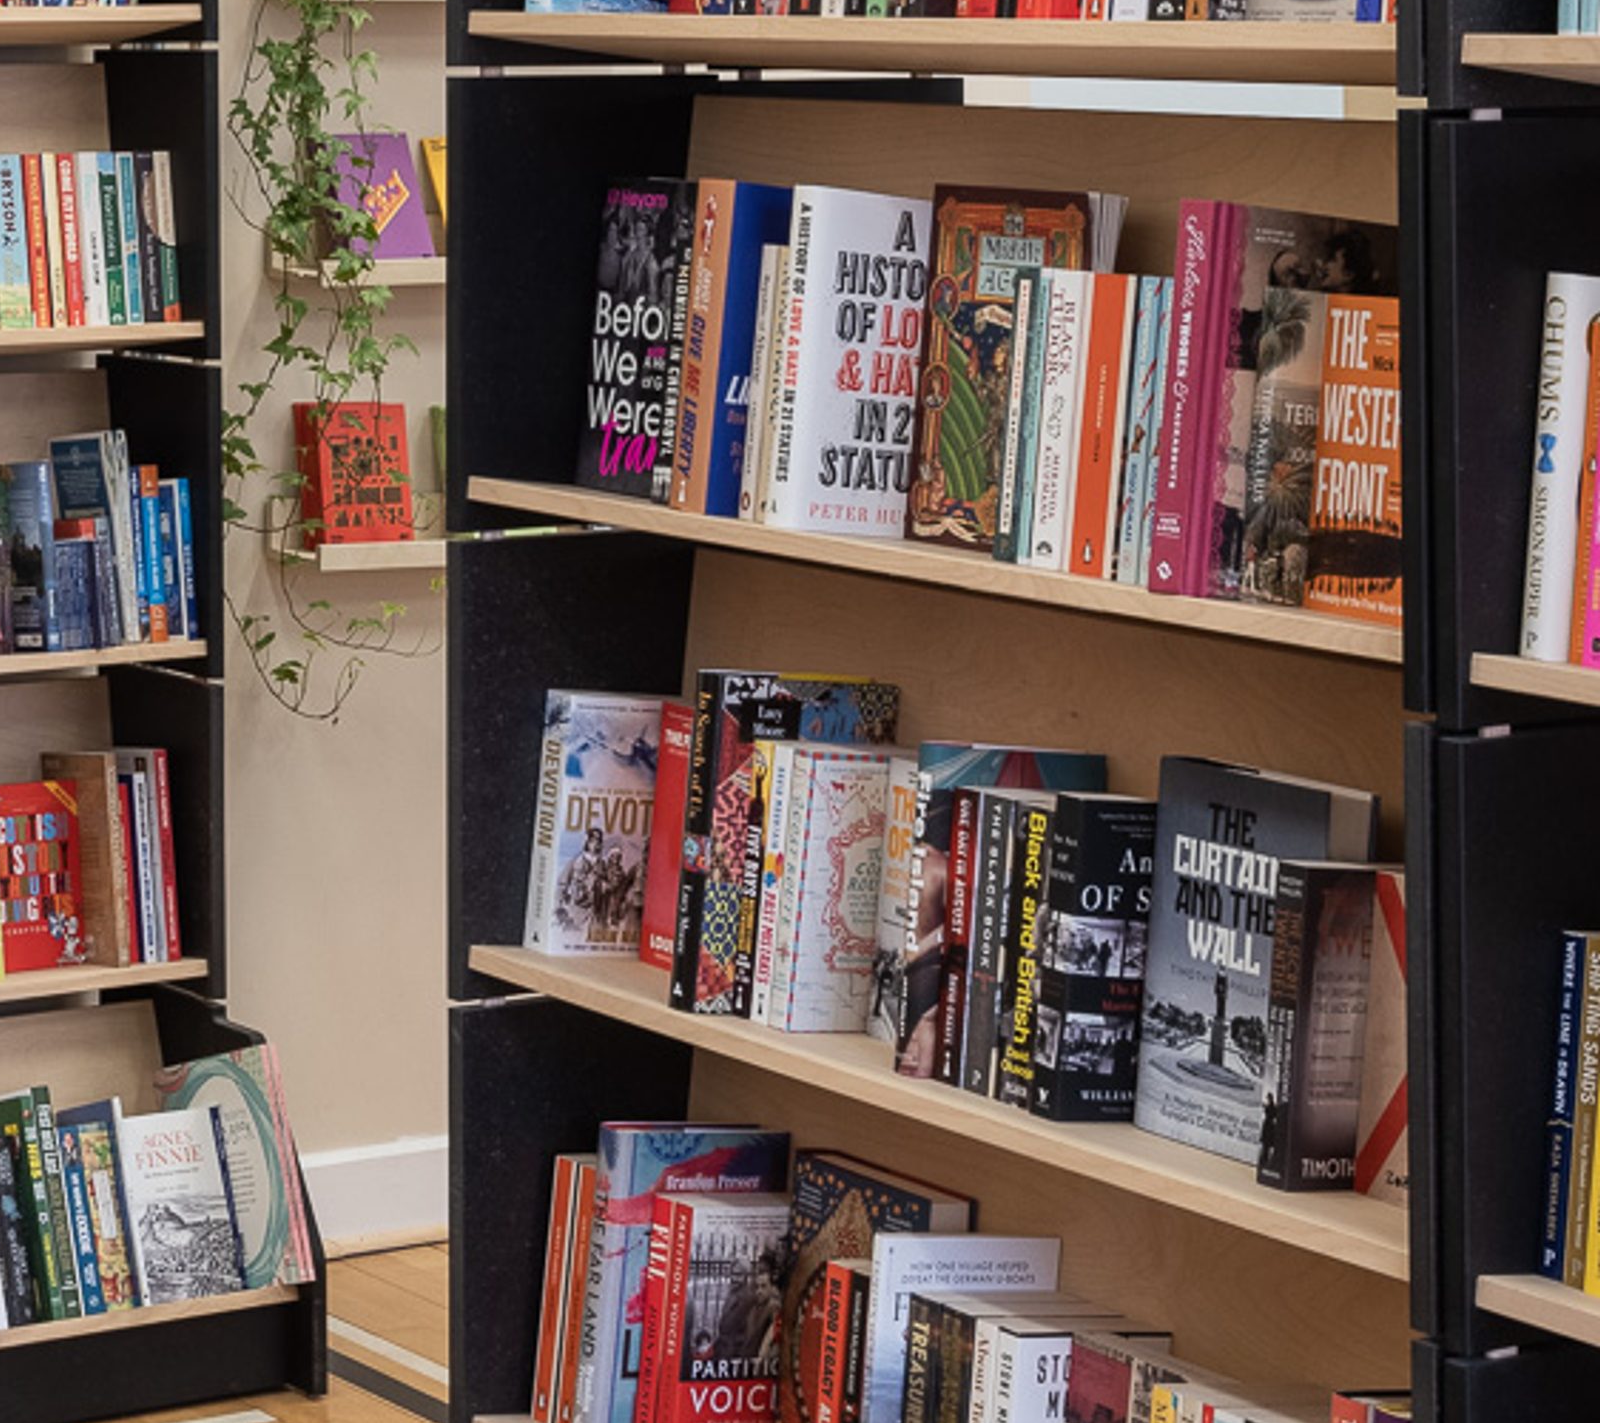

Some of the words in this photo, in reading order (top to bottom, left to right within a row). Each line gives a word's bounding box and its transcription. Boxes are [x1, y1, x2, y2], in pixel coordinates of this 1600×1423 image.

[0, 168, 16, 232] BRYSON
[894, 210, 917, 253] A
[689, 314, 705, 361] GIVE
[838, 300, 877, 345] OF
[881, 306, 924, 349] LO
[1176, 311, 1192, 377] WHORES
[1329, 307, 1369, 370] THE
[593, 340, 638, 385] We
[686, 363, 700, 395] ME
[836, 349, 862, 391] &
[1538, 296, 1567, 423] CHUMS
[589, 385, 661, 436] Were
[853, 399, 888, 441] IN
[678, 397, 698, 479] LIBERTY
[808, 502, 869, 522] PETER
[1315, 457, 1388, 521] FRONT
[1532, 485, 1549, 543] SIMON
[1526, 550, 1543, 620] KUPER
[753, 724, 786, 739] Moore
[757, 706, 783, 720] Lucy
[537, 739, 561, 849] DEVOTION
[565, 796, 655, 836] DEVOT
[1028, 811, 1048, 889] Black
[1210, 803, 1258, 850] THE
[1023, 895, 1040, 945] and
[1174, 879, 1224, 922] AND
[1228, 892, 1277, 939] THE
[1185, 921, 1261, 977] WALL
[1015, 957, 1037, 1039] British
[1580, 1042, 1600, 1106] SANDS
[136, 1146, 201, 1170] FINNIE
[142, 1129, 193, 1148] AGNES
[1302, 1158, 1358, 1180] TIMOTH
[648, 1219, 671, 1282] FALL
